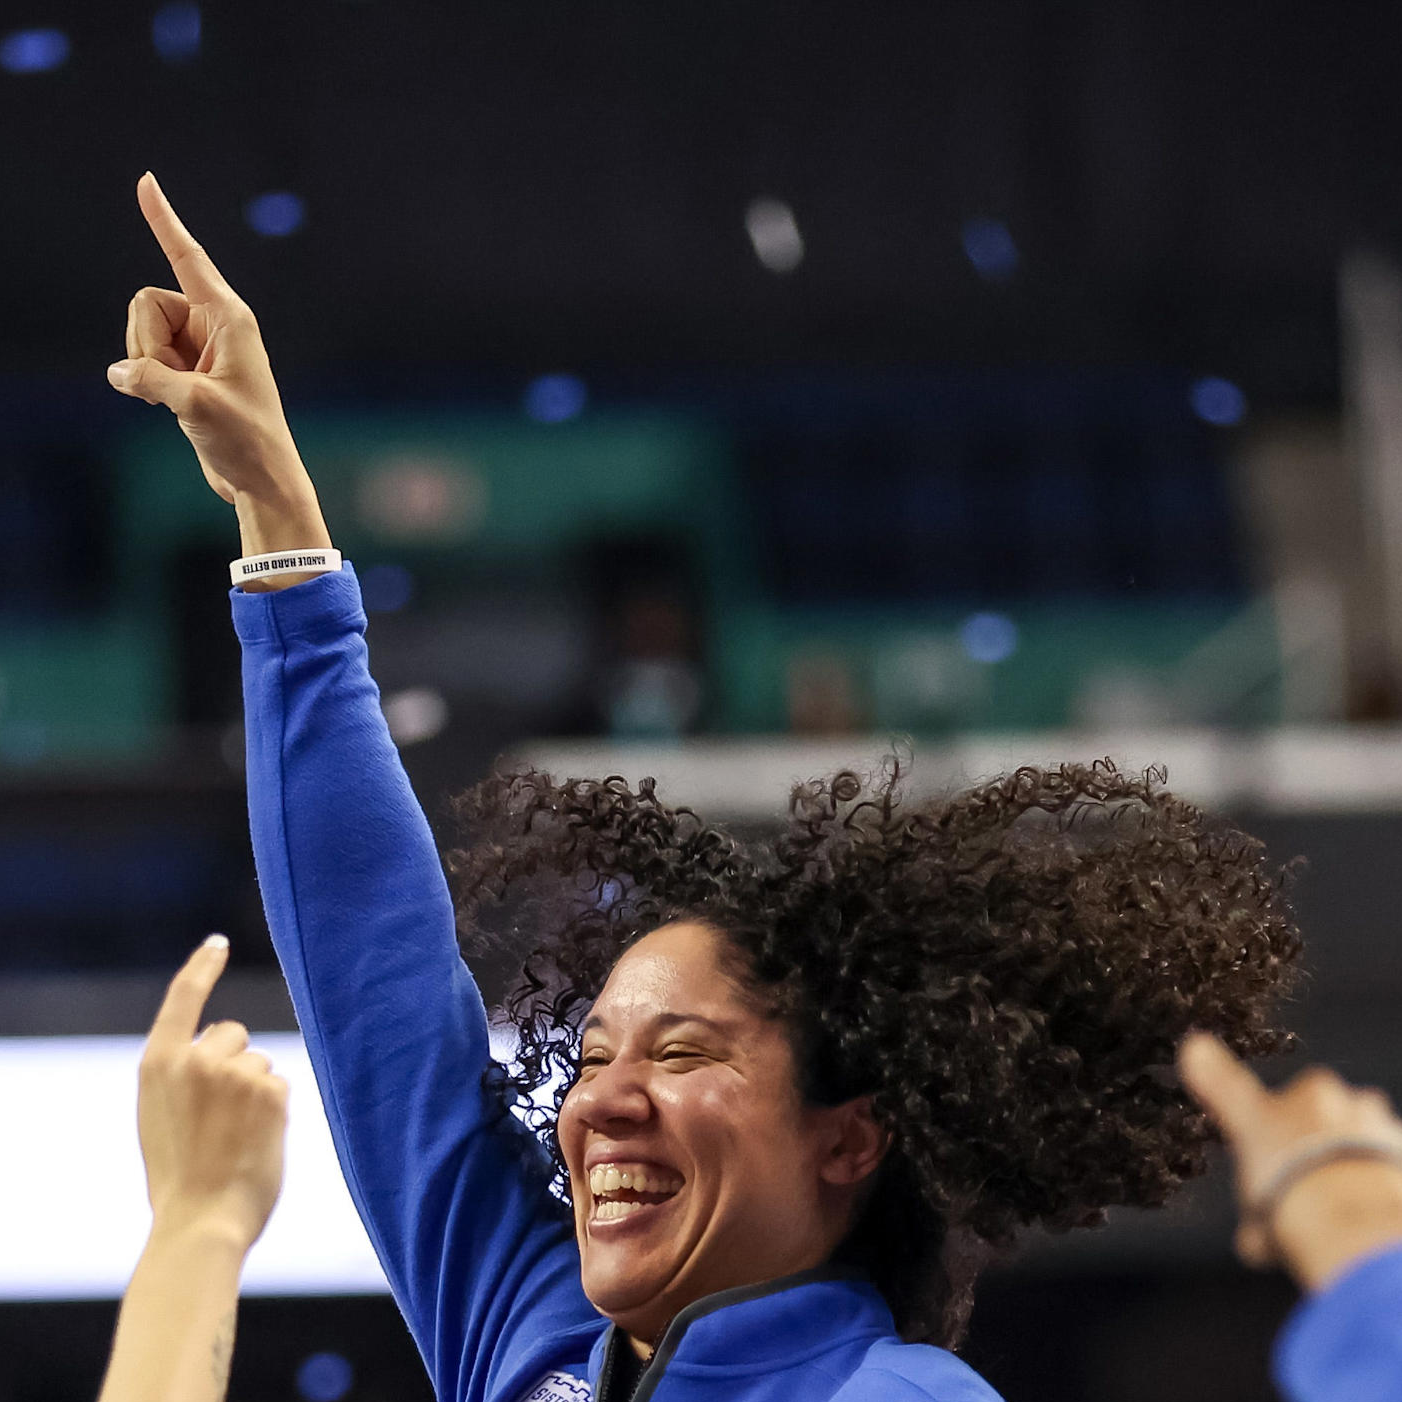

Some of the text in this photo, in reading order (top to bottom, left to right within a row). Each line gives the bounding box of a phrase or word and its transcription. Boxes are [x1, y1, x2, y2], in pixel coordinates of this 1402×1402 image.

[243, 556, 325, 574] HANDLE HARD BETTER
